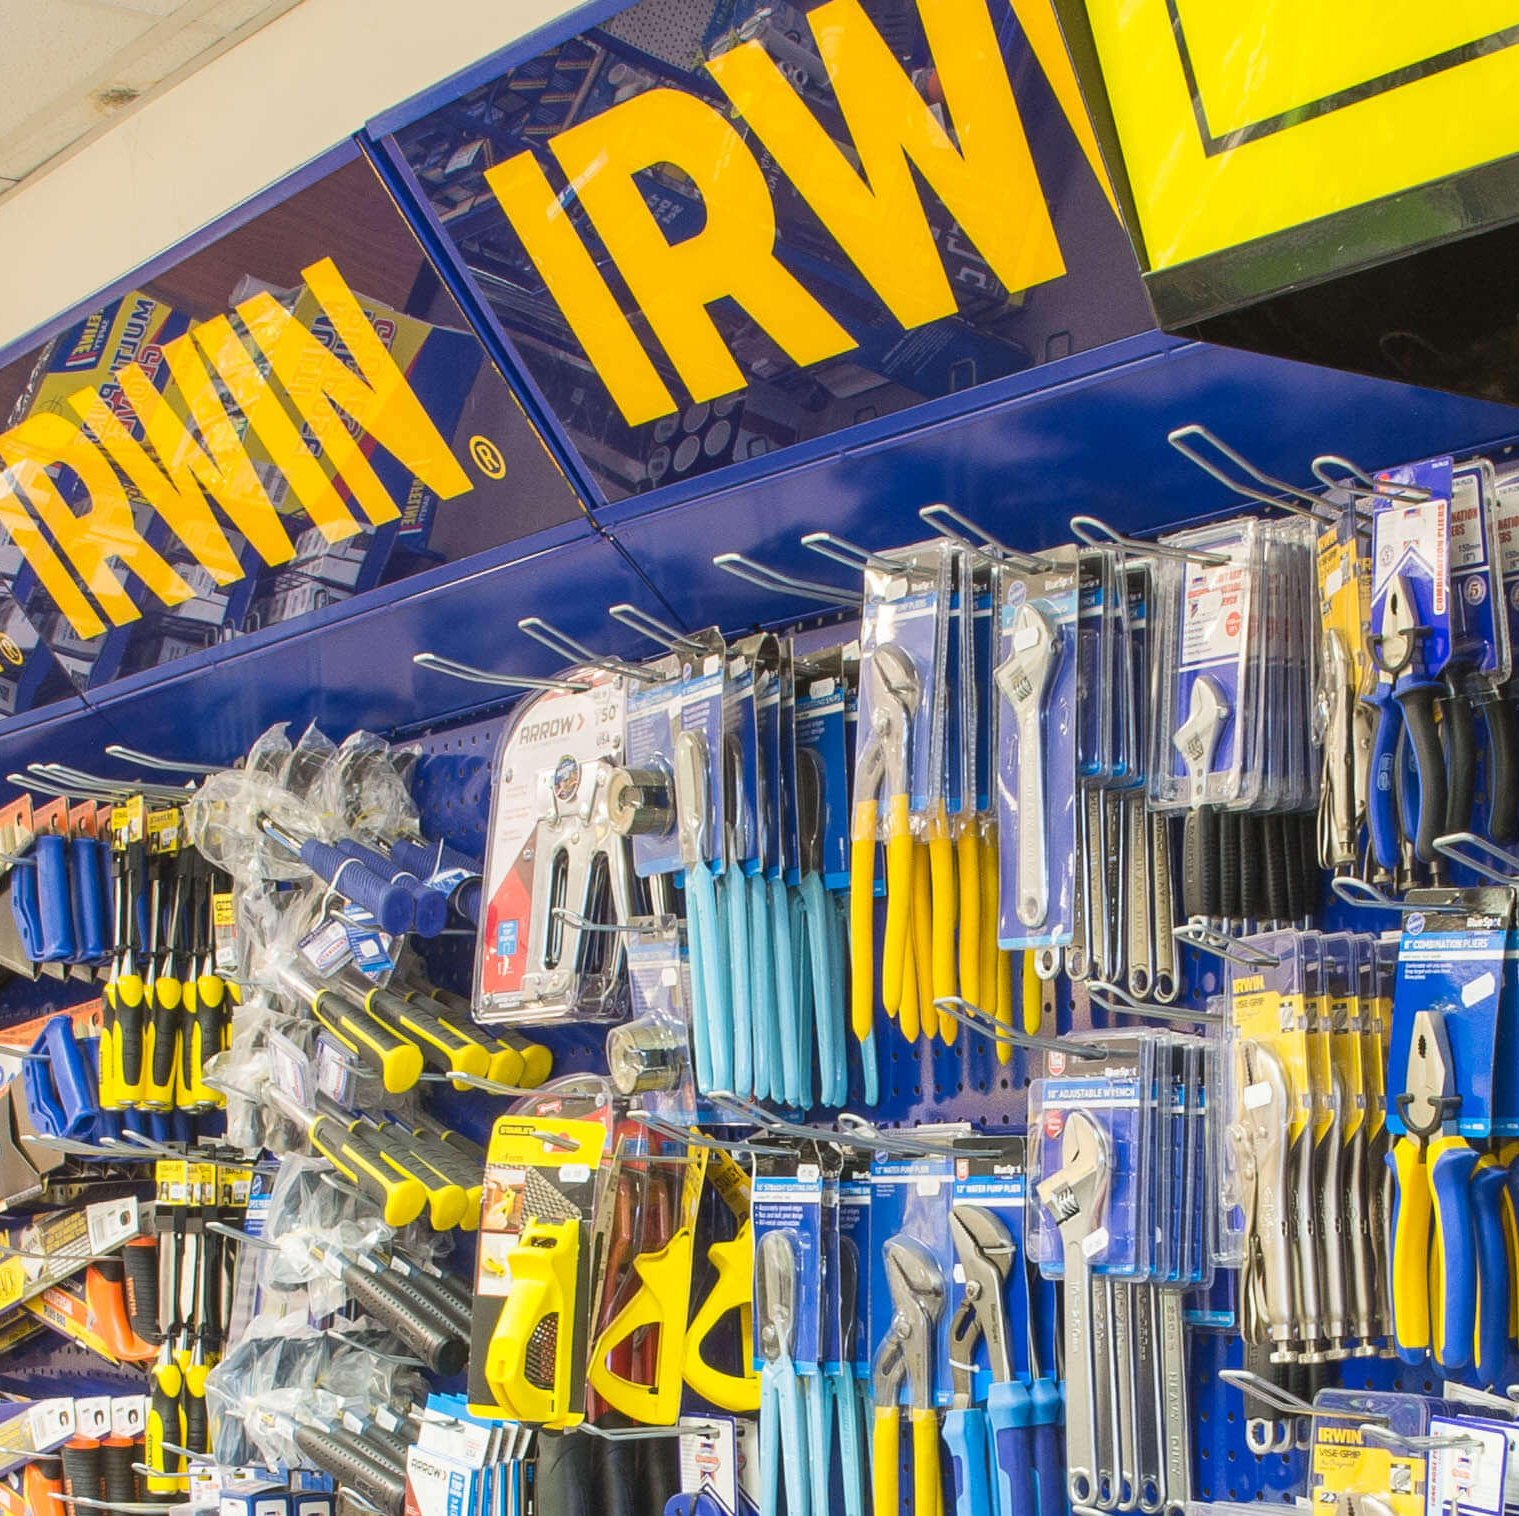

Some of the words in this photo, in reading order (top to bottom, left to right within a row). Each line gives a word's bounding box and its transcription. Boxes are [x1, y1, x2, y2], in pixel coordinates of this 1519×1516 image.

[517, 716, 576, 745] ARROW
[1414, 937, 1462, 950] COMBINATION
[1463, 937, 1488, 949] PLIERS
[1060, 1087, 1103, 1098] ADJUSTABLE
[1105, 1086, 1136, 1097] WRENCH
[1318, 1427, 1363, 1446] IRWIN
[1317, 1447, 1362, 1462] VISE-GRIP
